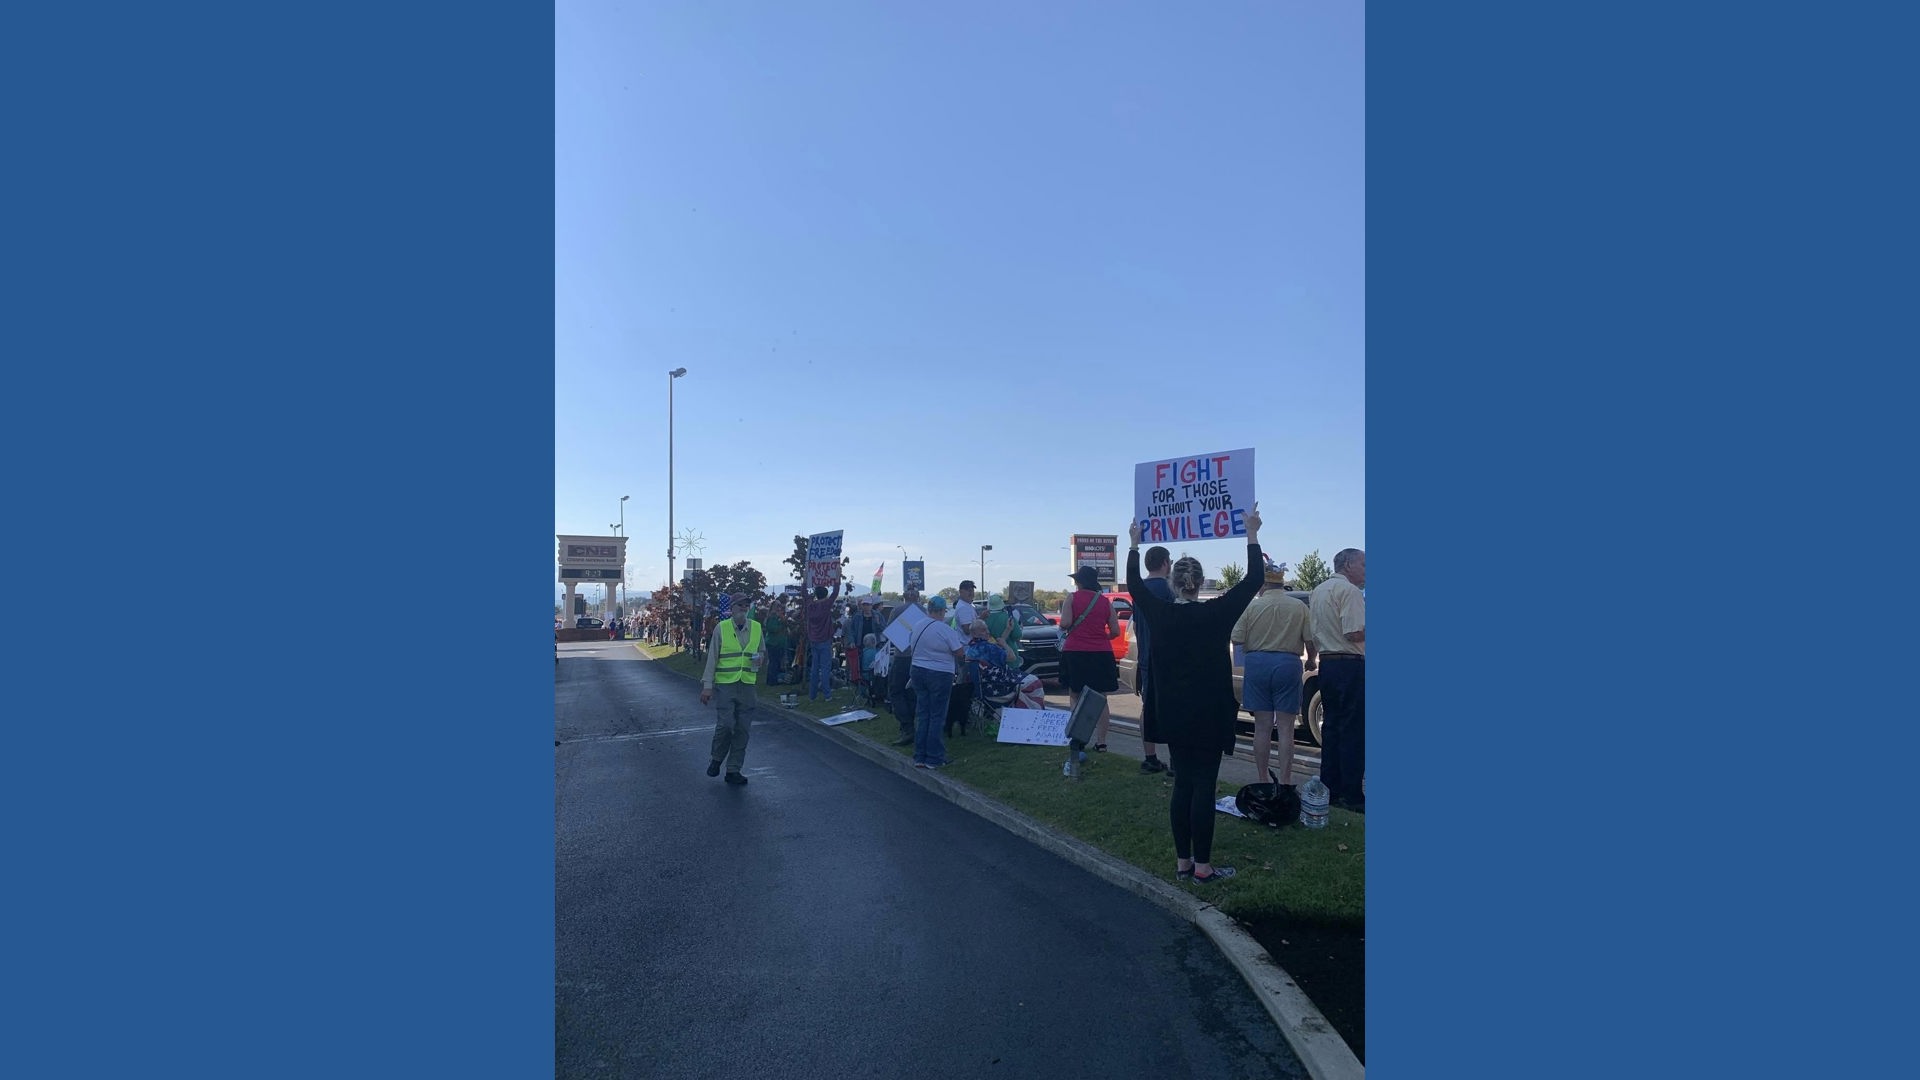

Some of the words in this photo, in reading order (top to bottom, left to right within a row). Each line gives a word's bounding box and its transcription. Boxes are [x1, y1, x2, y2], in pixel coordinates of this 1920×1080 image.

[1155, 456, 1230, 488] FIGHT
[1152, 488, 1175, 504] FOR
[1182, 479, 1228, 499] THOSE
[1147, 500, 1193, 518] WITHOUT
[1199, 494, 1233, 512] YOUR
[1140, 508, 1247, 542] PRIVILEGE
[811, 535, 842, 548] PROTECT
[808, 561, 840, 571] PROTECT
[815, 569, 830, 577] OUR
[1042, 712, 1067, 720] MAKE
